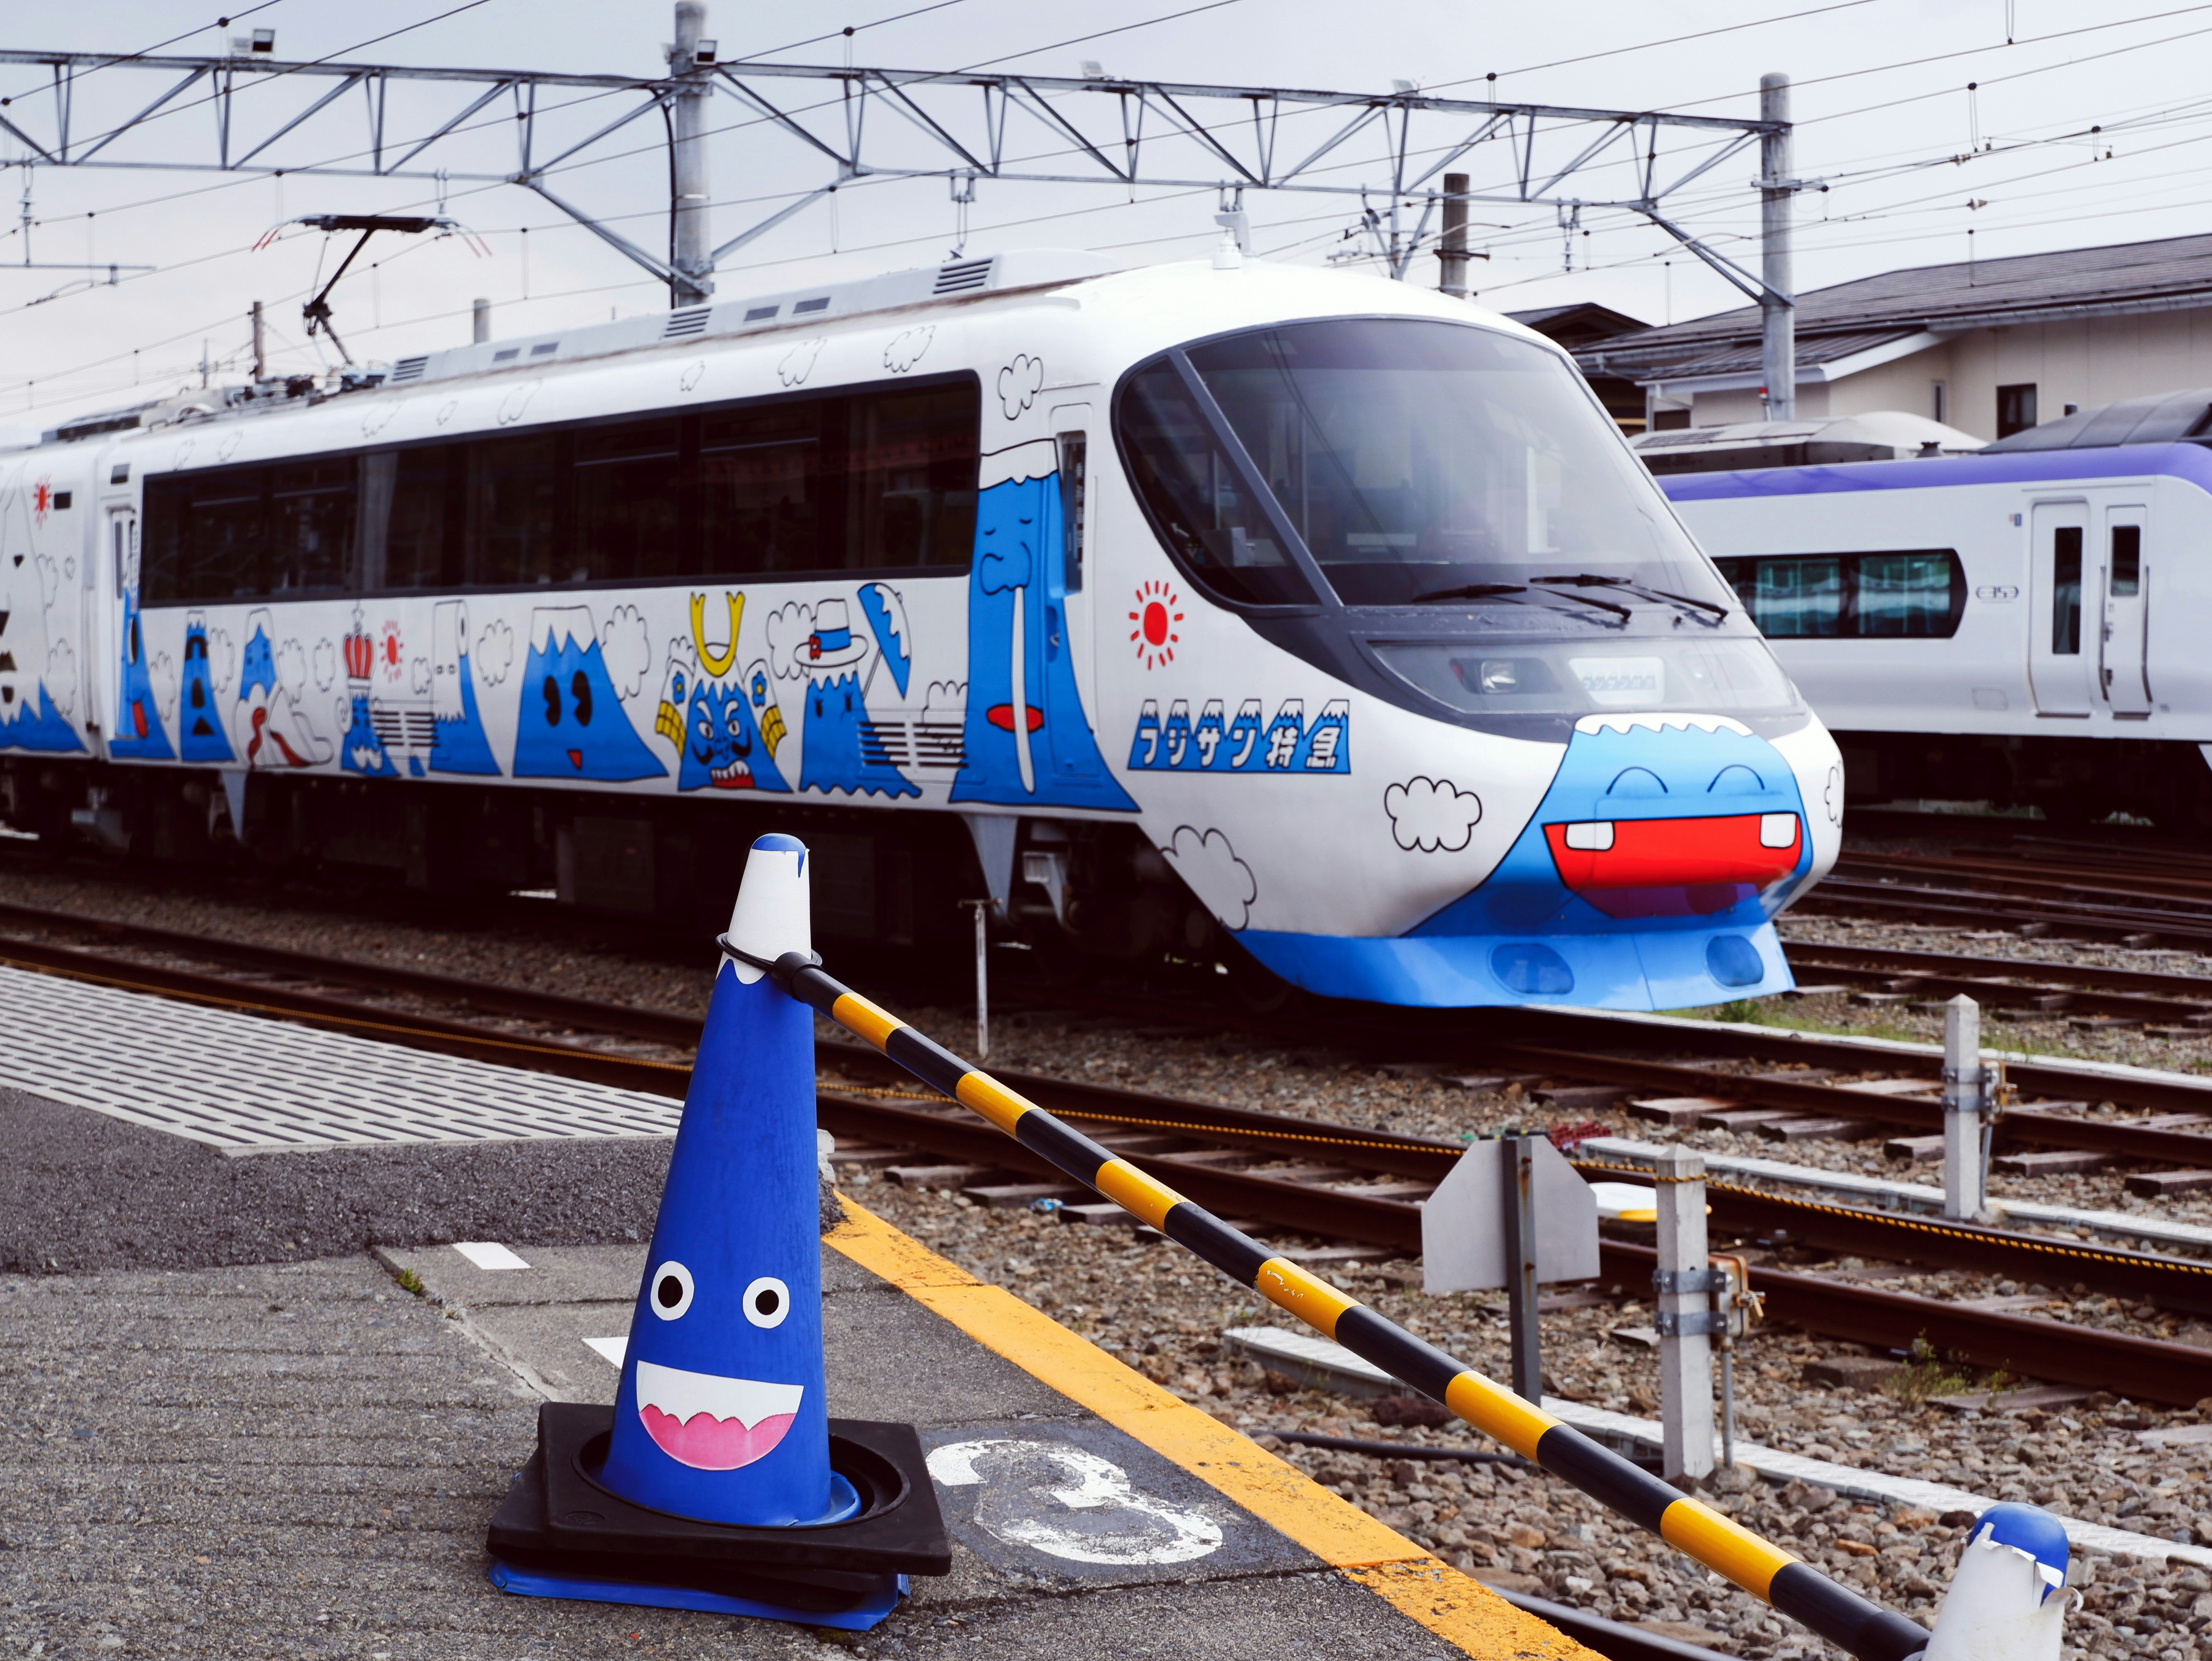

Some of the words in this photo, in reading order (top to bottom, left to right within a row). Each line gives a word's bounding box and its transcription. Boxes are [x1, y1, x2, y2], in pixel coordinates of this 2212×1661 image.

[1140, 727, 1341, 768] フジサン特急
